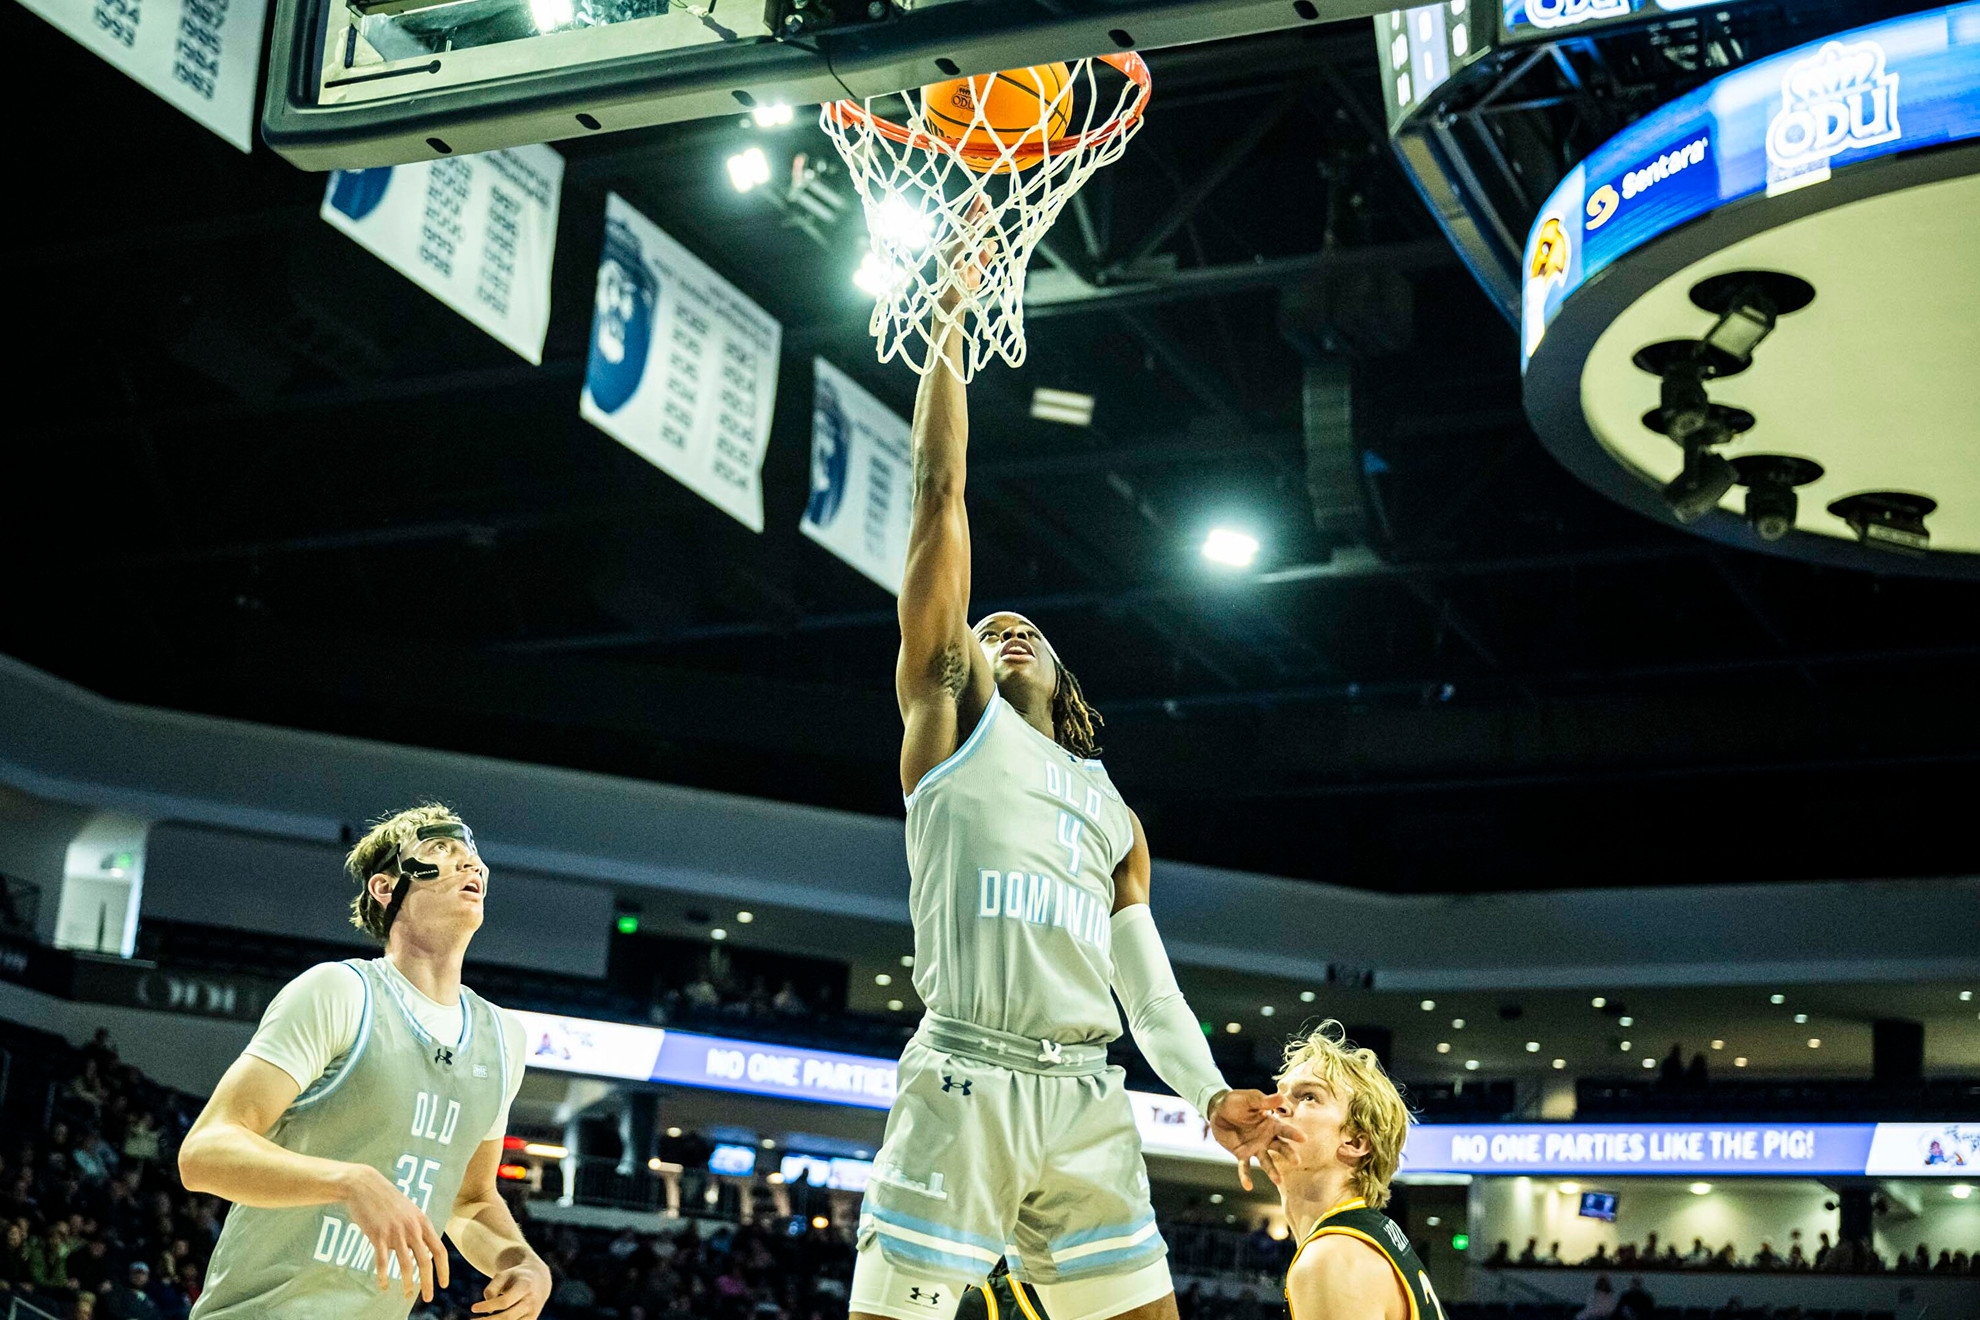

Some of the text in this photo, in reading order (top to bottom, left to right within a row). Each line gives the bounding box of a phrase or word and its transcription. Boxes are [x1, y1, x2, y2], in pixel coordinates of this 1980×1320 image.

[953, 95, 976, 111] ODU
[1770, 82, 1891, 161] ODU
[1622, 138, 1706, 200] Sentara
[1045, 759, 1103, 822] OLD
[1057, 811, 1083, 876] 4
[979, 868, 1111, 950] DOMINIO
[706, 1048, 746, 1080] NO
[747, 1053, 801, 1087] ONE
[411, 1091, 461, 1145] OLD
[1452, 1129, 1815, 1163] NO ONE PARTIES LIKE THE PIG!
[396, 1154, 441, 1214] 35
